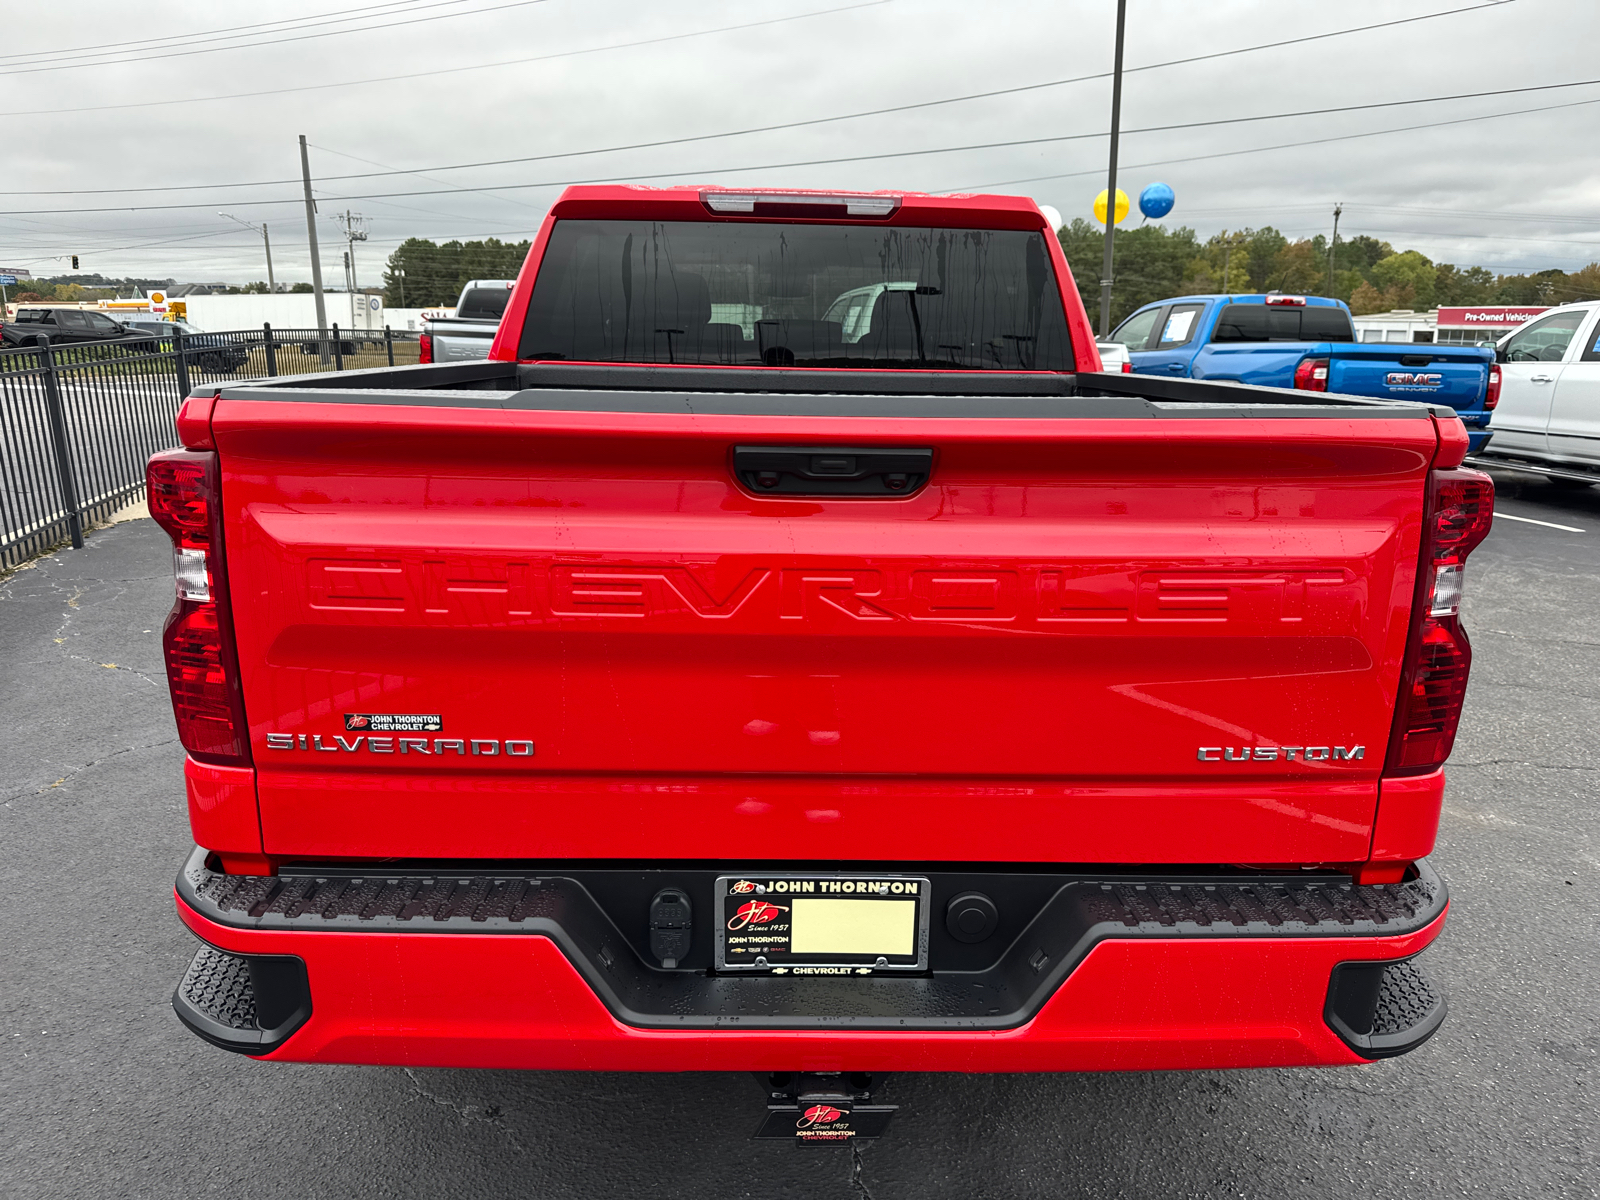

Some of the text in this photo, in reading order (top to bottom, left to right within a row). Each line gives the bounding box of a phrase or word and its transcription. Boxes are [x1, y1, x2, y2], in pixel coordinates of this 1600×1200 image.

[1465, 313, 1504, 322] Pre-Owned
[1387, 373, 1442, 386] GMC
[306, 557, 1350, 622] CHEVROLET
[370, 715, 392, 723] JOHN
[266, 733, 534, 756] SILVERADO
[1197, 746, 1366, 761] CUSTOM
[766, 881, 814, 893] JOHN
[747, 924, 769, 932] Since
[728, 936, 748, 944] JOHN
[792, 967, 852, 975] CHEVROLET
